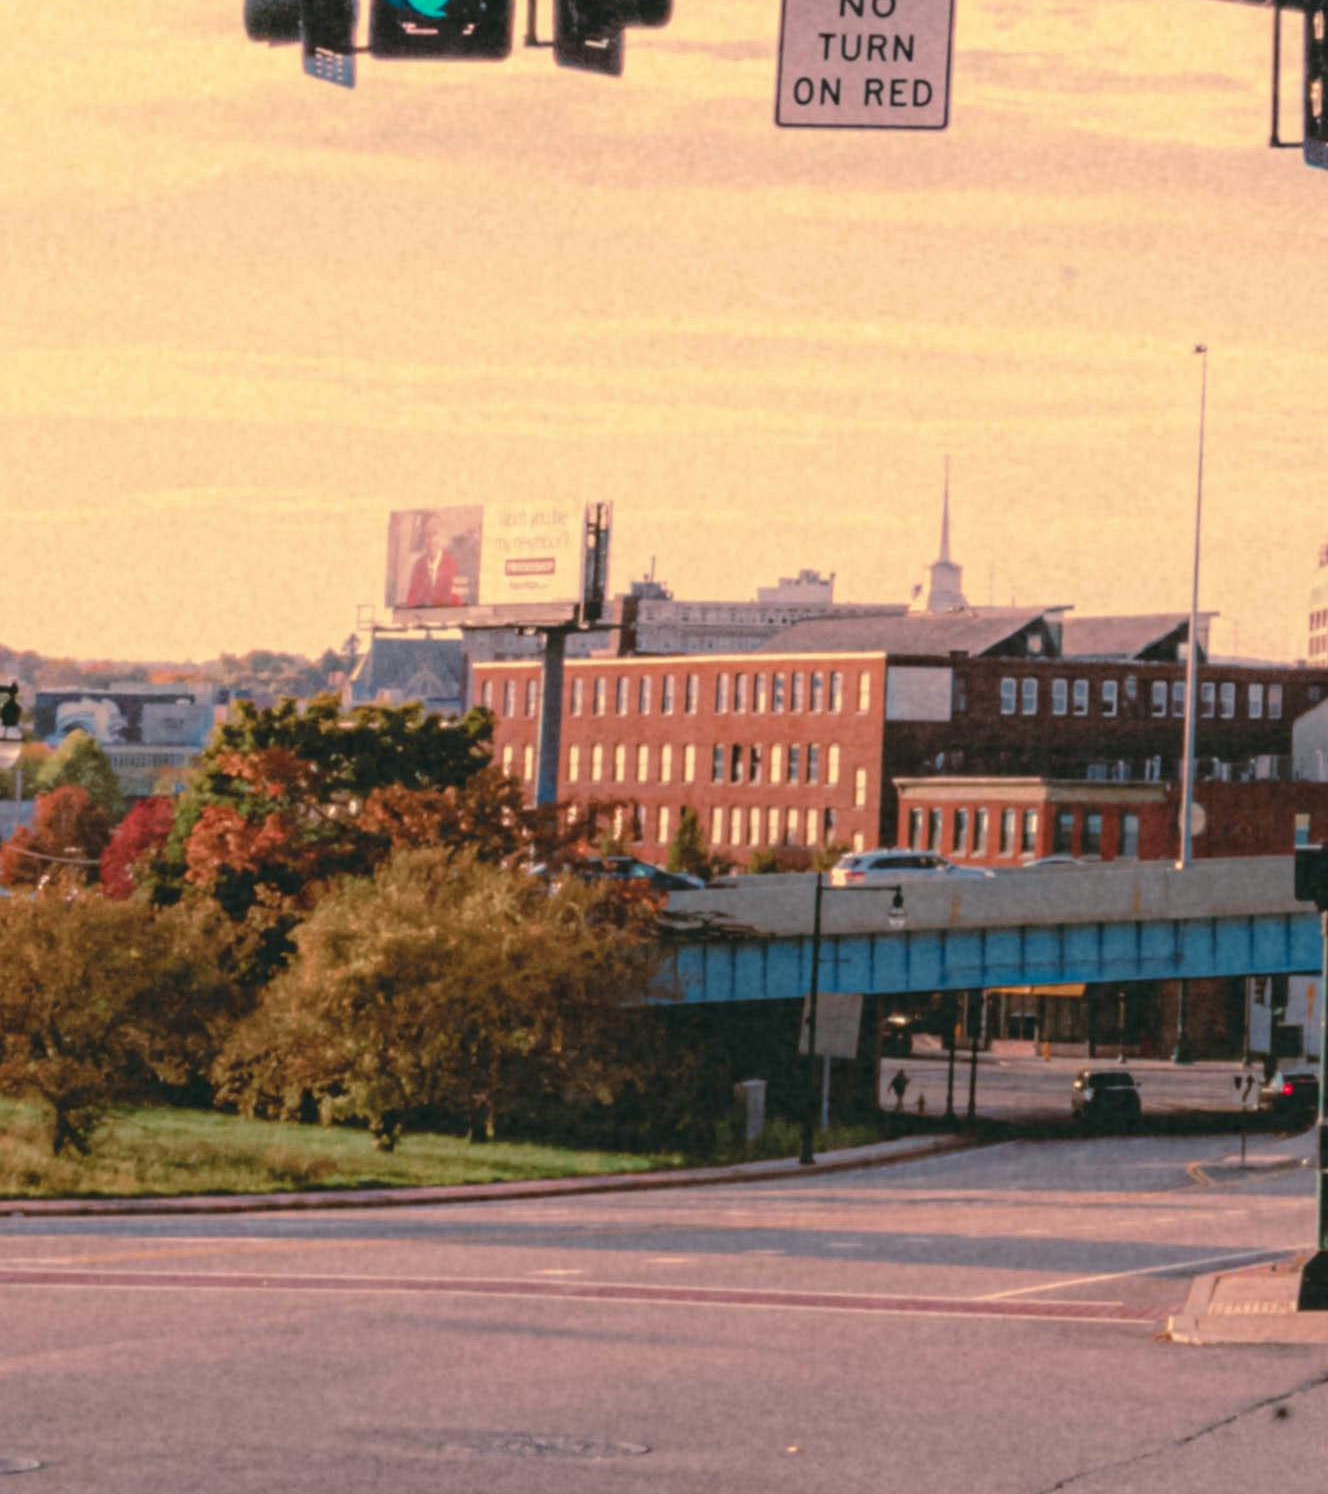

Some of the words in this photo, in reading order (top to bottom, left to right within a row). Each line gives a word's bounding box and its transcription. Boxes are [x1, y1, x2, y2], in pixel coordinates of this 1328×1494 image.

[818, 32, 915, 62] TURN
[793, 76, 842, 106] ON
[864, 78, 933, 107] RED
